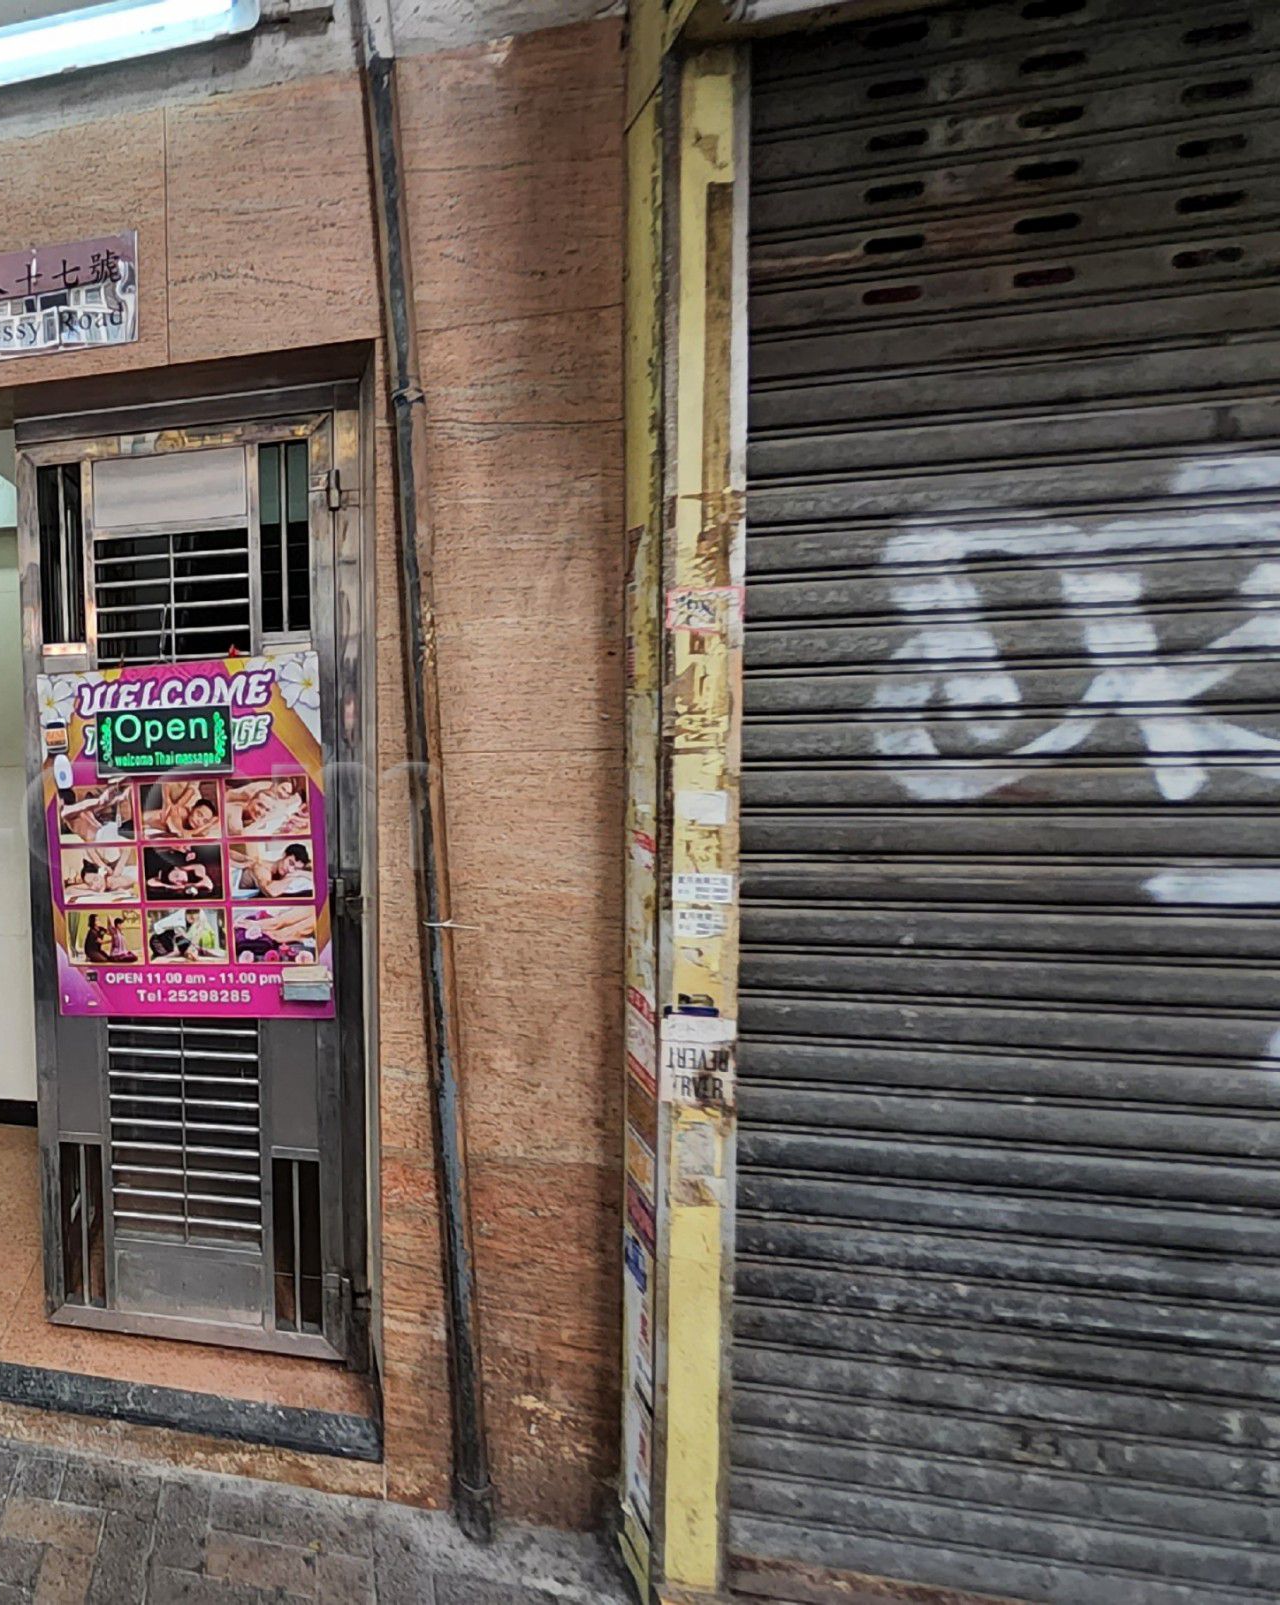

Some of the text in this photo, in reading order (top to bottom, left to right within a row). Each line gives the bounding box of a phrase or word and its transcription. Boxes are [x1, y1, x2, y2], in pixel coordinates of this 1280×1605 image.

[58, 309, 124, 332] Road
[79, 671, 273, 716] WELCOME
[114, 714, 209, 748] Open
[115, 752, 154, 767] welcome
[154, 751, 175, 765] Thai
[105, 972, 143, 984] OPEN
[146, 972, 183, 984] 11.00
[185, 974, 206, 984] am
[219, 971, 256, 984] 11.00
[259, 974, 281, 987] pm
[136, 988, 251, 1003] Tel.25298285
